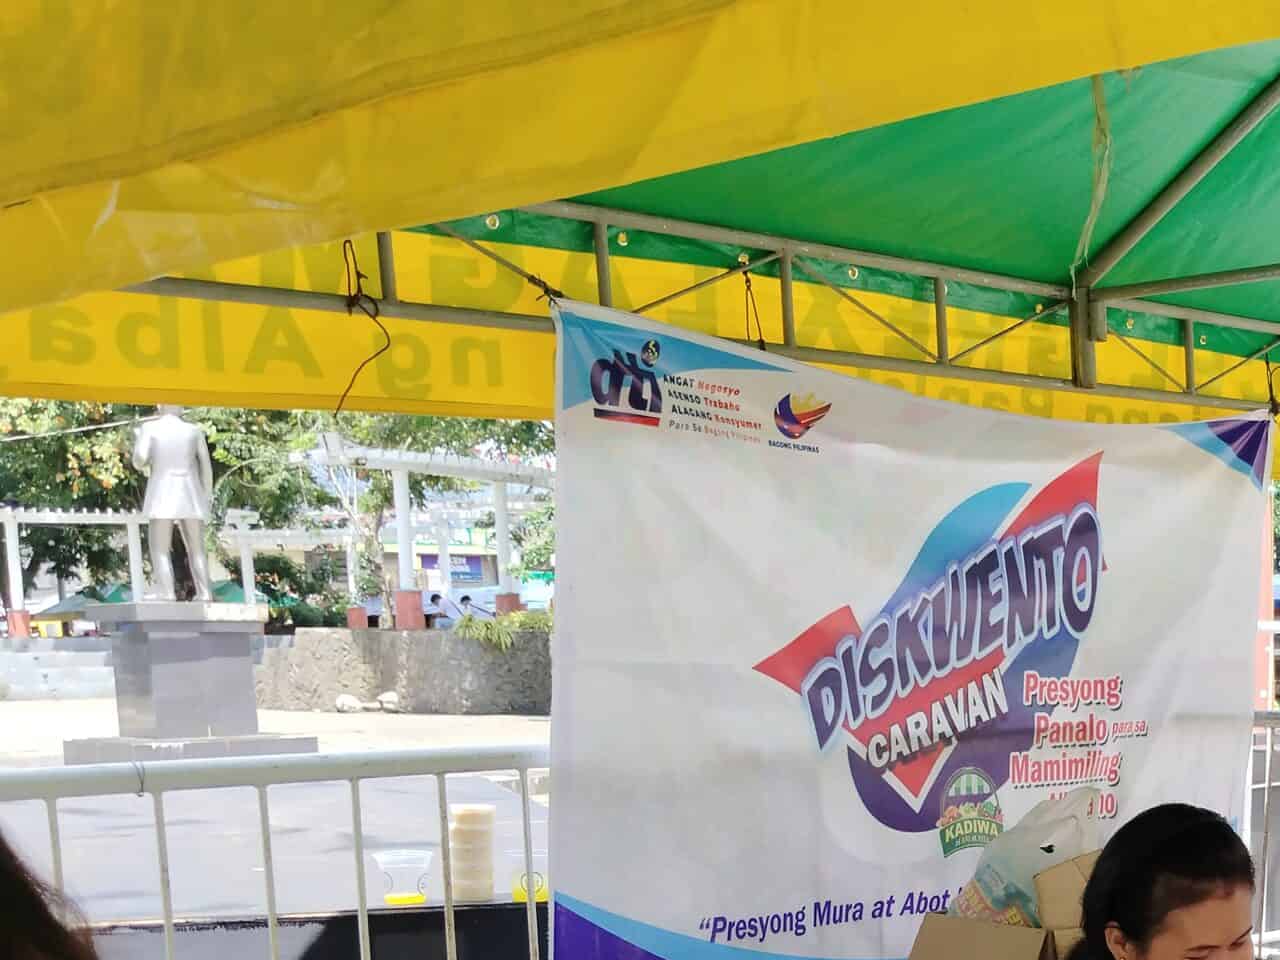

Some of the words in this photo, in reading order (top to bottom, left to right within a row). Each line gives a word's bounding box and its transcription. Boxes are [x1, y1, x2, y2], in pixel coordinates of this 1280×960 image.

[804, 506, 1102, 753] DISKWENTO
[1023, 671, 1123, 710] Presyong
[866, 668, 1009, 768] CARAVAN
[1035, 713, 1108, 748] Panalo
[1010, 751, 1122, 788] Mamimiling
[944, 819, 999, 844] KADIWA
[813, 899, 864, 928] Mura
[871, 894, 896, 919] at
[900, 887, 951, 916] Abot
